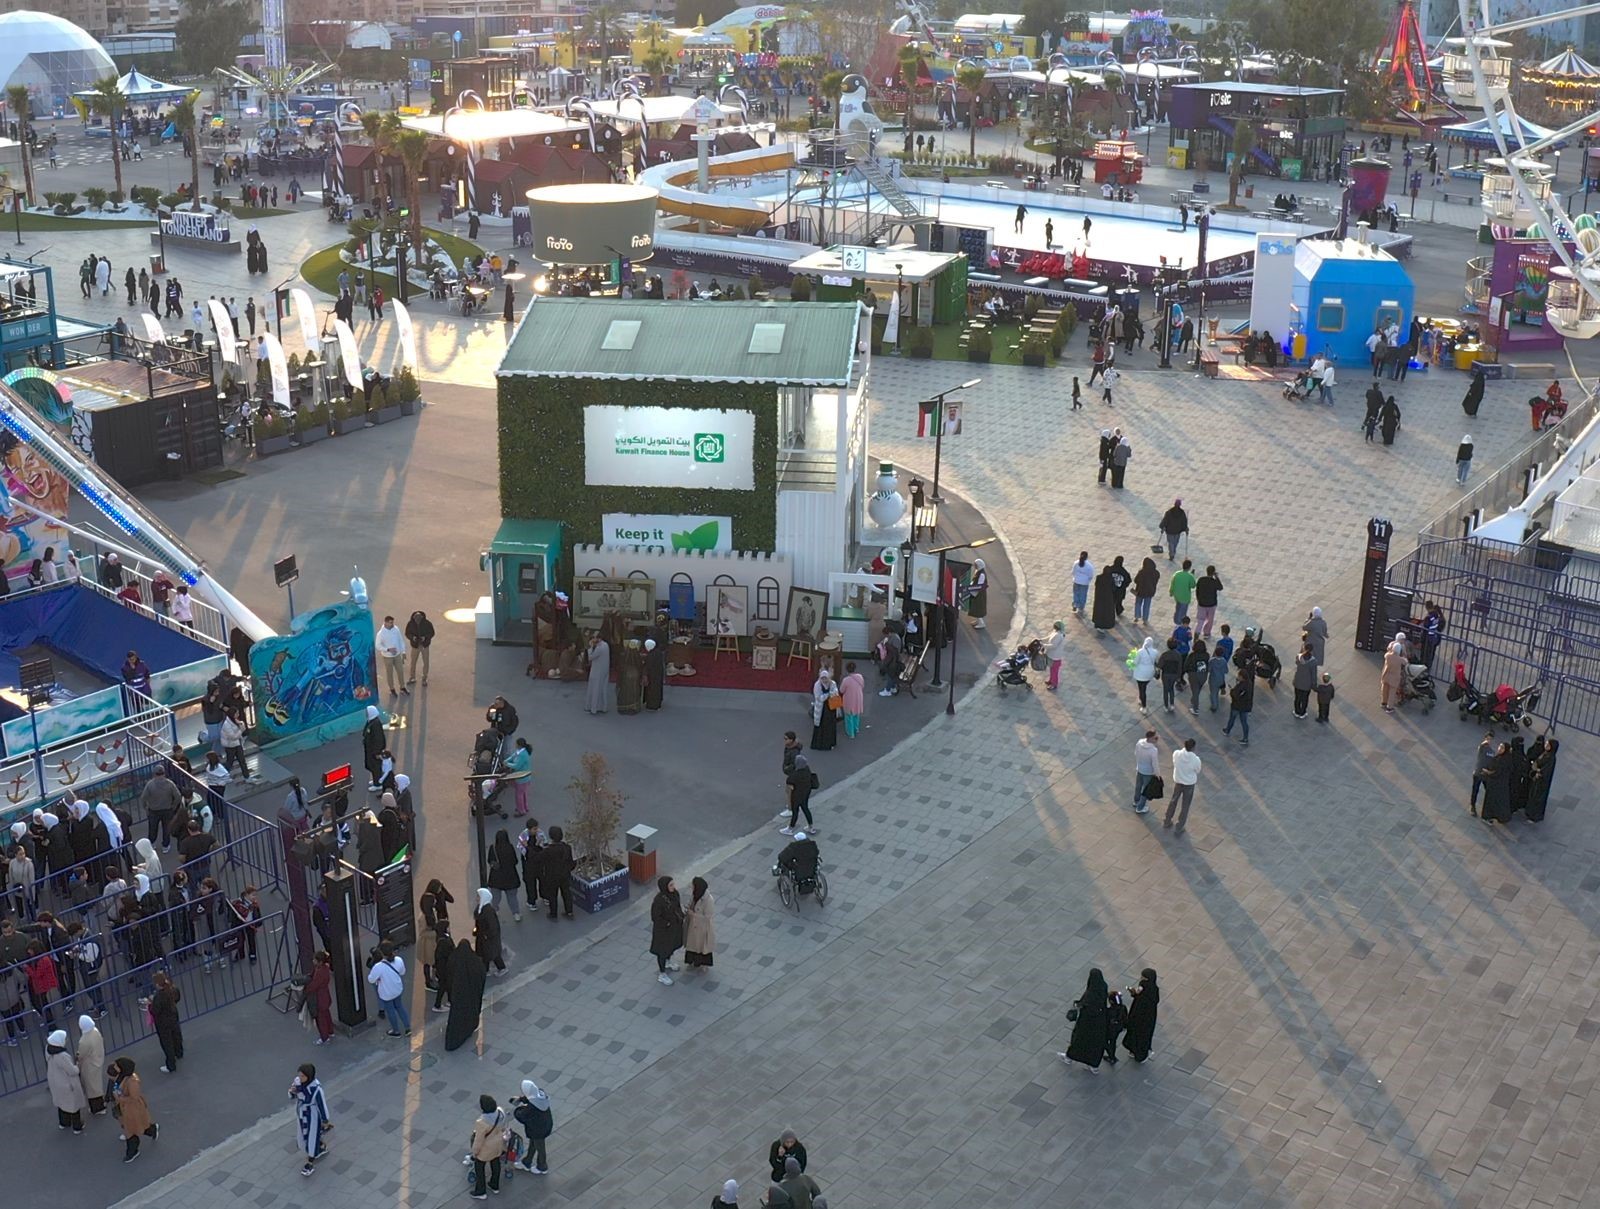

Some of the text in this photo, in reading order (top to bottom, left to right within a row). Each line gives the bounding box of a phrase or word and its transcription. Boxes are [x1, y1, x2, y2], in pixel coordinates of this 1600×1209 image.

[171, 213, 207, 228] WINTER
[676, 438, 690, 448] بيت
[614, 447, 690, 457] Kuwait Finance House
[615, 528, 665, 542] Keep it
[1373, 523, 1387, 538] 11
